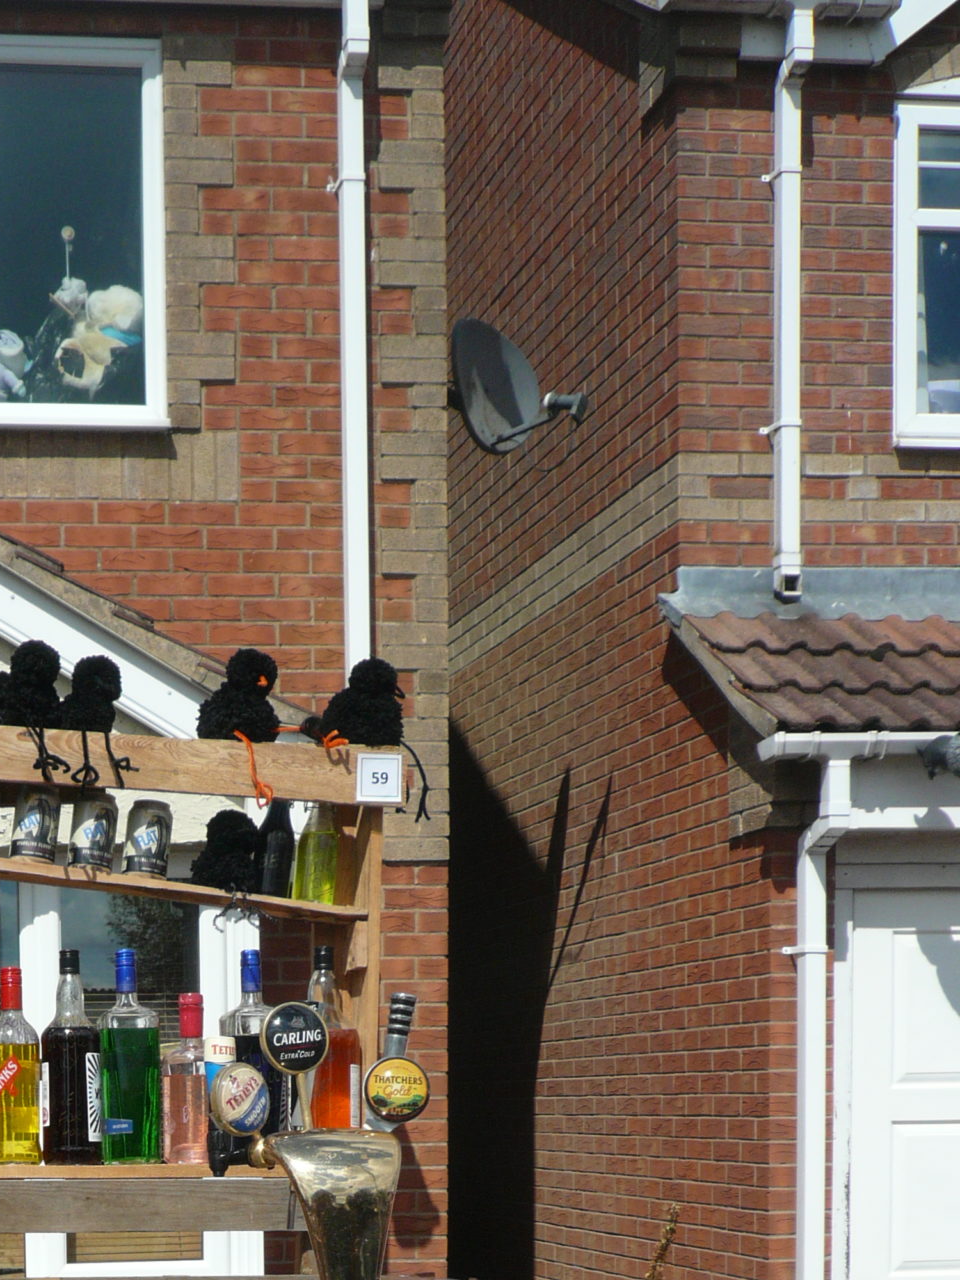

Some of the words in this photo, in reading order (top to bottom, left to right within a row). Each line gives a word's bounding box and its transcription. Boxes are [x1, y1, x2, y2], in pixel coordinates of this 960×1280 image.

[371, 771, 389, 785] 59
[273, 1028, 322, 1047] CARLING
[373, 1074, 424, 1086] THATCHERS
[382, 1084, 413, 1099] Gold
